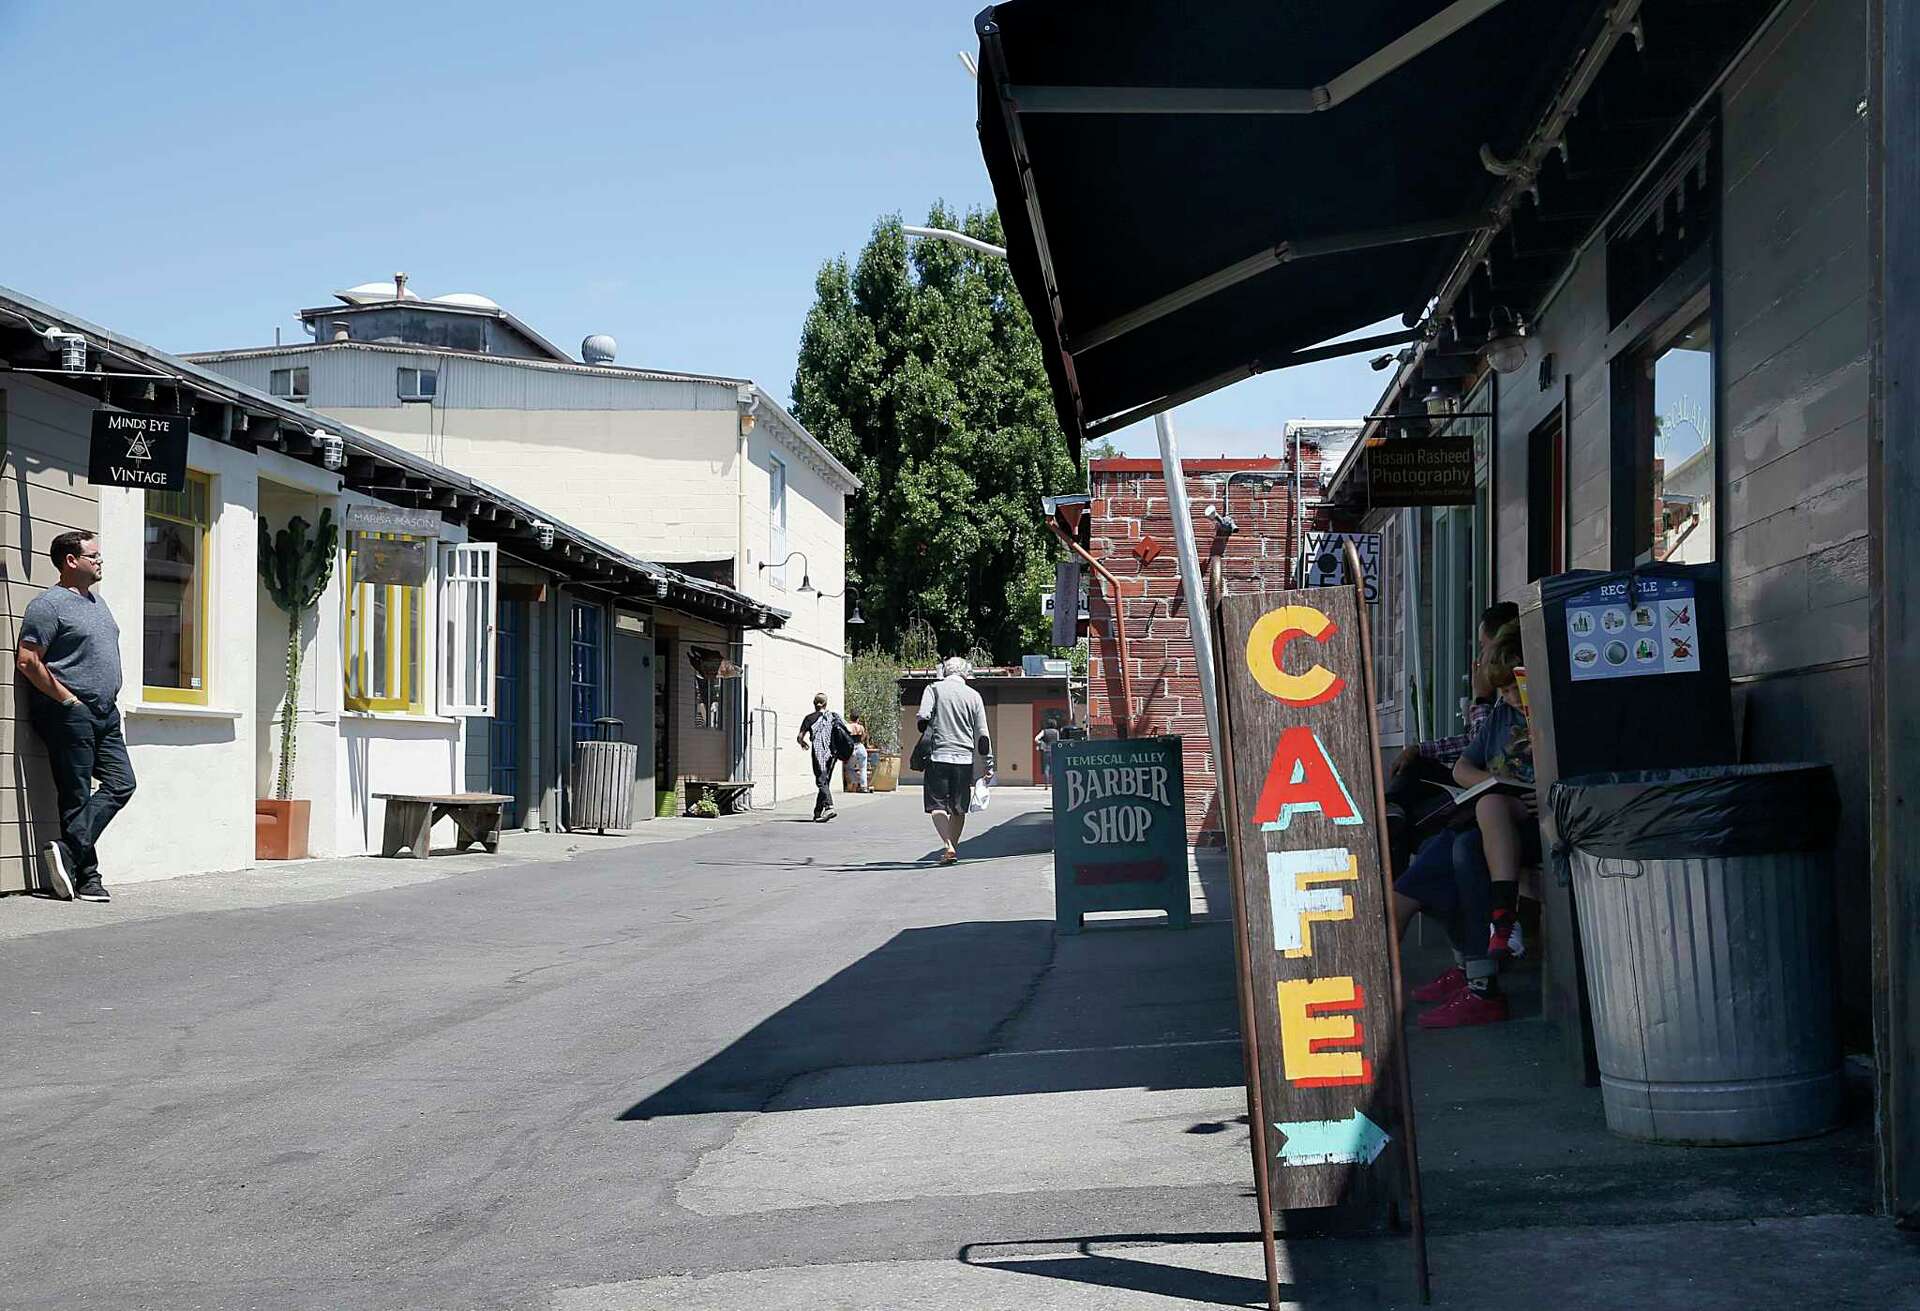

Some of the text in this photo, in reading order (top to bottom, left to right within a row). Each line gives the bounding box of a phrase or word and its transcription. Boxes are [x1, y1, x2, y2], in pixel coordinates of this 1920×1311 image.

[108, 416, 170, 432] MINDS EYE
[1372, 448, 1470, 465] Hasain Rasheed
[110, 466, 167, 485] VINTAGE
[1373, 466, 1471, 486] Photography
[1306, 534, 1379, 554] WAVE
[1601, 581, 1658, 596] RECLE
[1066, 752, 1166, 766] TEMESCAL ALLEY
[1065, 766, 1171, 812] BARBER
[1082, 806, 1152, 844] SHOP
[1246, 605, 1373, 1088] CAFE
